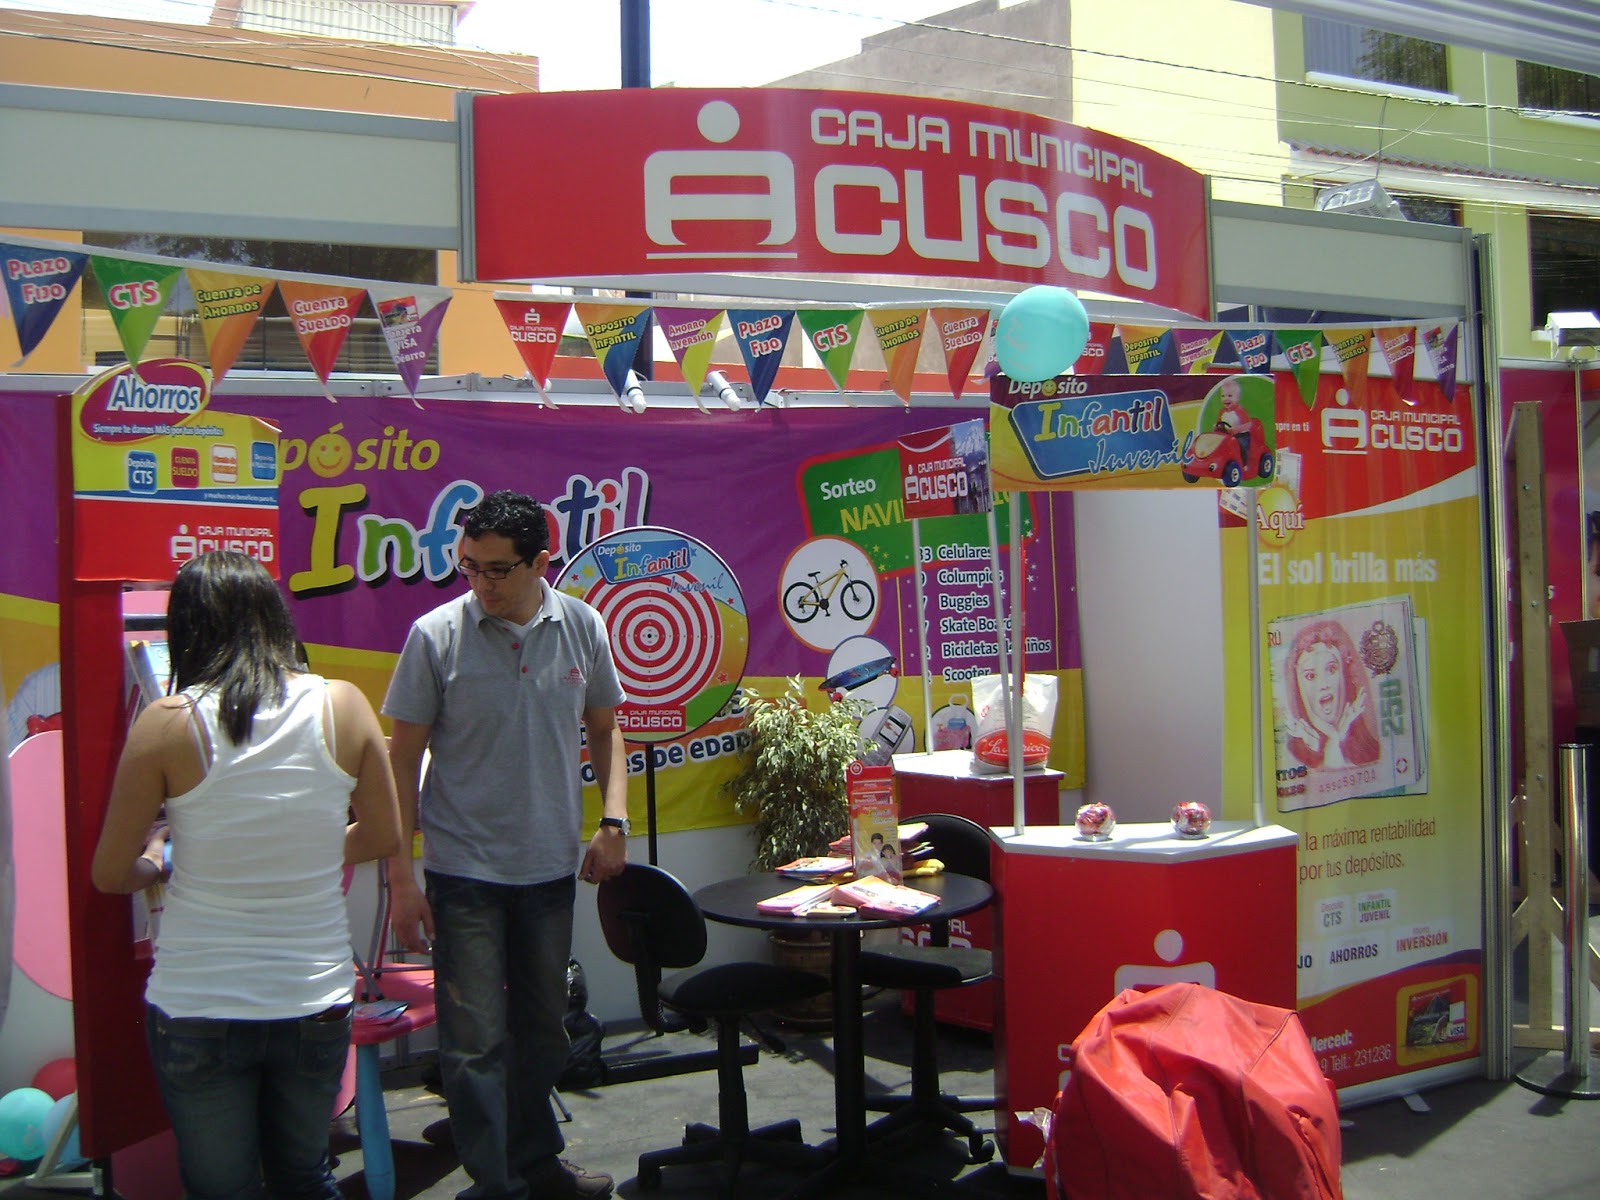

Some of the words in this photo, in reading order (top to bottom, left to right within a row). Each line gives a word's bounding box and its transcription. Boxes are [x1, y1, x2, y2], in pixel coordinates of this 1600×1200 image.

[810, 108, 952, 155] CAJA
[968, 121, 1154, 199] MUNICIPAL
[813, 164, 1158, 292] CUSCO
[109, 280, 161, 309] CTS
[511, 331, 557, 343] CUSCO
[813, 324, 850, 351] CTS
[1286, 341, 1317, 365] CTS
[113, 376, 201, 413] Ahorros
[1034, 396, 1163, 442] Infantil
[1370, 410, 1400, 422] CAJA
[1402, 411, 1461, 425] MUNICIPAL
[1371, 424, 1462, 452] CUSCO
[278, 423, 440, 485] pósito
[1088, 431, 1196, 475] Juvenil
[132, 470, 153, 485] CTS
[820, 478, 876, 500] Sorteo
[919, 471, 969, 501] CUSCO
[1256, 504, 1304, 538] Aquí
[614, 548, 689, 580] Infantil
[1259, 553, 1281, 585] El
[1288, 552, 1322, 583] sol
[1330, 551, 1388, 583] brilla
[1395, 552, 1438, 582] más
[666, 572, 724, 593] Juvenil
[940, 592, 989, 612] Buggies
[941, 618, 976, 633] Skate
[942, 640, 999, 658] Bicicletas
[630, 716, 683, 728] CUSCO
[1304, 831, 1318, 851] la
[1322, 828, 1367, 849] máxima
[1370, 817, 1436, 842] rentabilidad
[1299, 864, 1322, 884] por
[1326, 860, 1342, 878] tus
[1358, 899, 1392, 912] INFANTIL
[1359, 909, 1391, 923] JUVENIL
[1323, 911, 1342, 928] CTS
[1329, 943, 1379, 965] AHORROS
[1354, 1044, 1391, 1067] 231236
